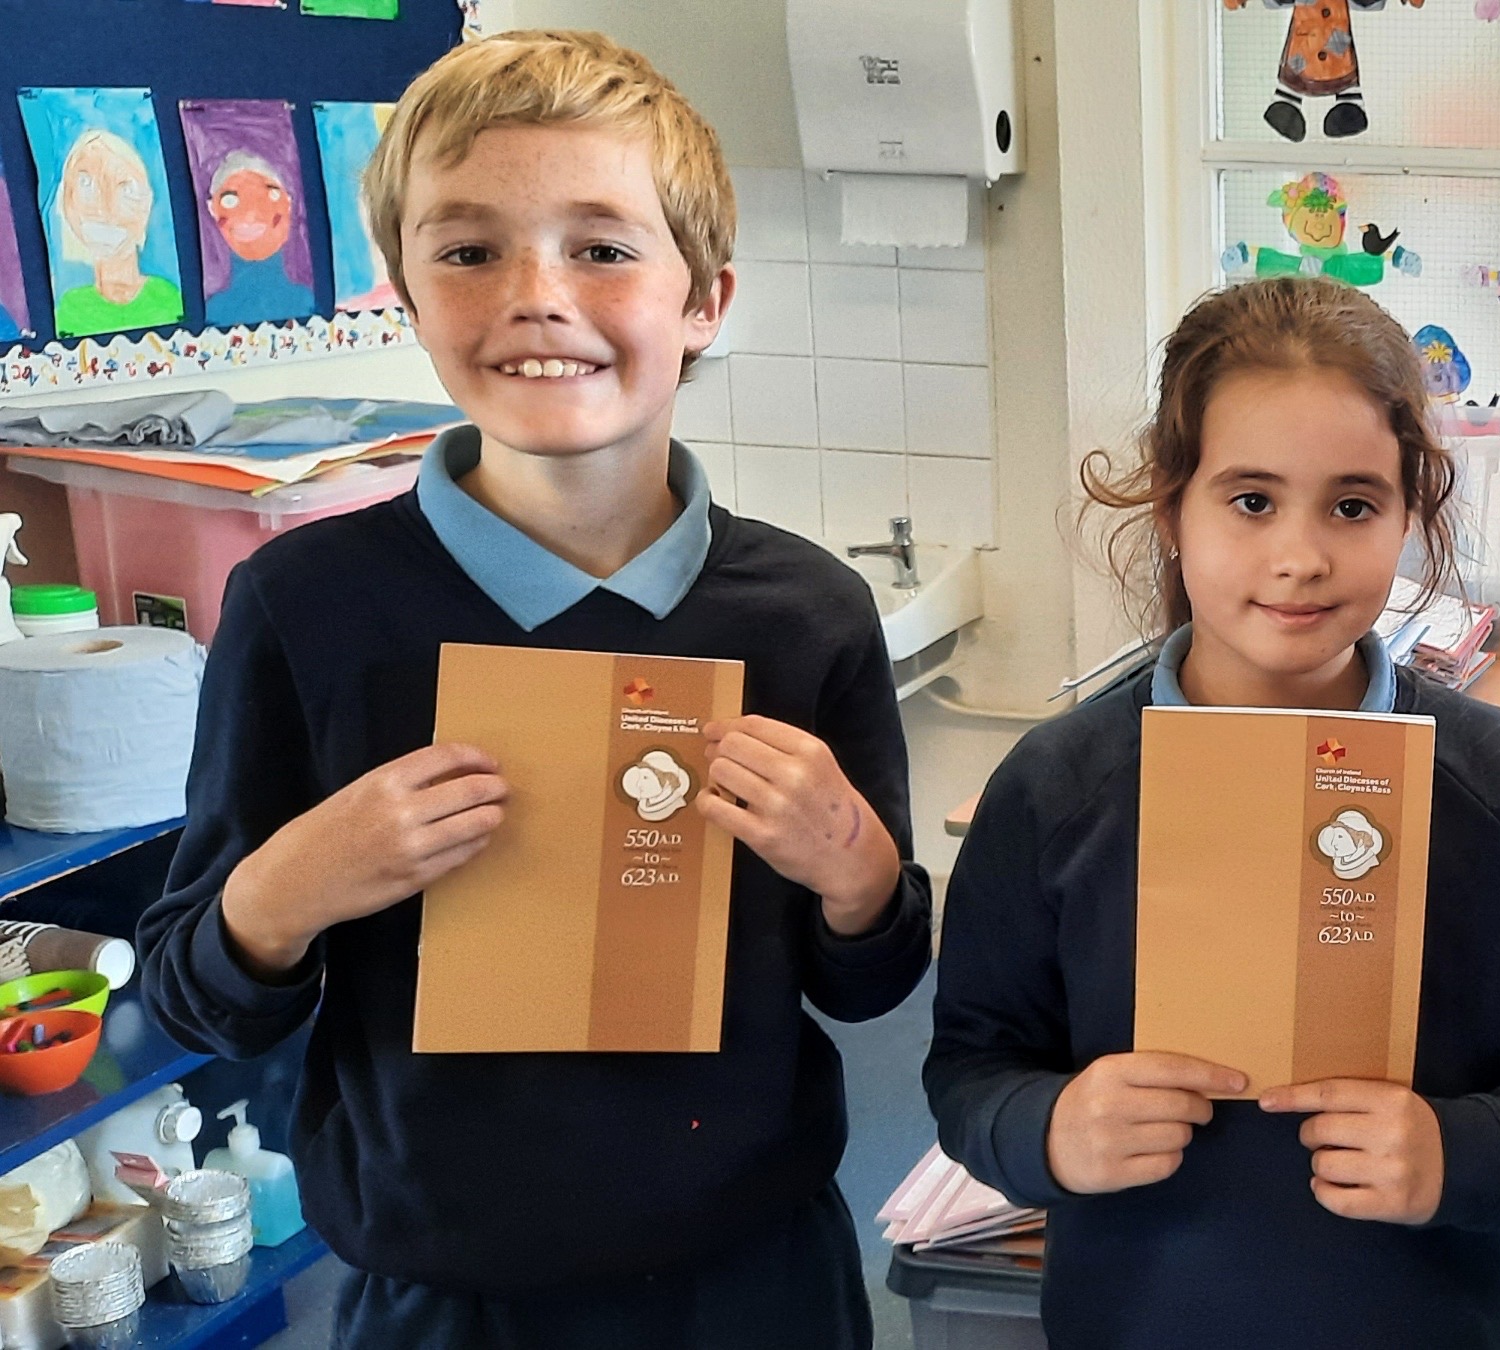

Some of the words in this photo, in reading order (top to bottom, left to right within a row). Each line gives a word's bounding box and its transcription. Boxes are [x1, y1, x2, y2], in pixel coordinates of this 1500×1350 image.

[1315, 775, 1342, 783] United
[1343, 776, 1379, 786] Dioceses
[1380, 778, 1389, 786] of
[1337, 784, 1365, 794] Cloyne
[1365, 785, 1372, 793] &
[1372, 786, 1392, 794] Ross
